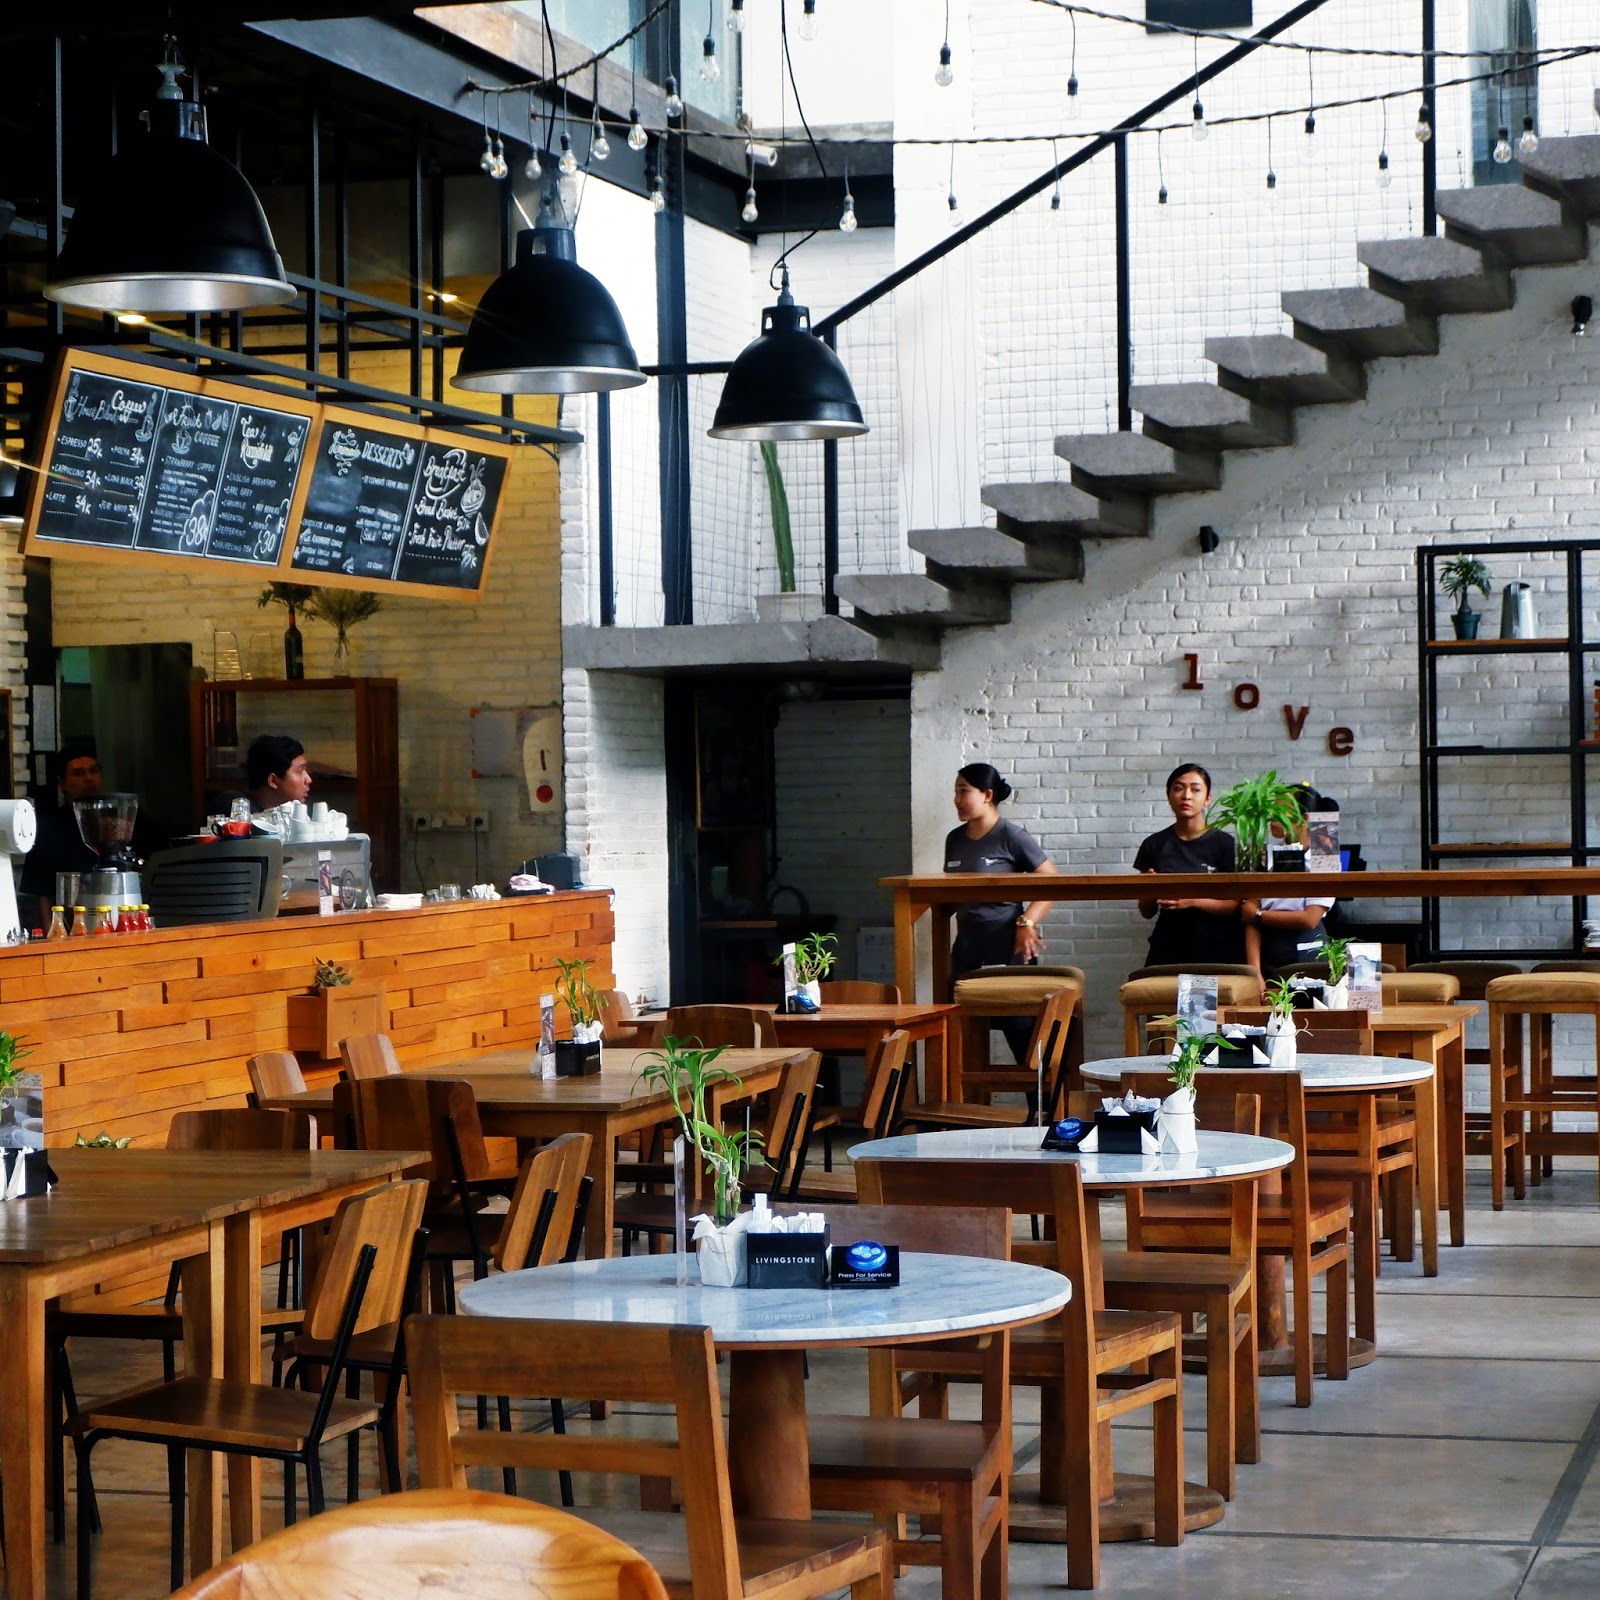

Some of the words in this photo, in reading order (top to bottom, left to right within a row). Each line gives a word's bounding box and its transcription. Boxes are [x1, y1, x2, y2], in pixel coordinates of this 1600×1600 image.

[111, 389, 147, 423] Coffee
[240, 414, 260, 439] Tea
[60, 435, 88, 449] ESPRESSO
[193, 430, 221, 448] COFFEE
[361, 440, 404, 470] DESSERTS
[53, 463, 86, 478] CAPPUCCINO
[165, 455, 195, 470] STRAWBERRY
[196, 461, 216, 473] COFFEE
[106, 473, 120, 484] LONG
[120, 476, 135, 487] BLACK
[422, 455, 467, 493] Breakfast
[47, 491, 67, 503] LATTE
[180, 485, 199, 498] COFFEE
[225, 485, 240, 497] EARL
[239, 486, 254, 498] GREY
[217, 524, 247, 539] PEPPERMINT
[755, 1256, 816, 1264] LIVINGSTONE
